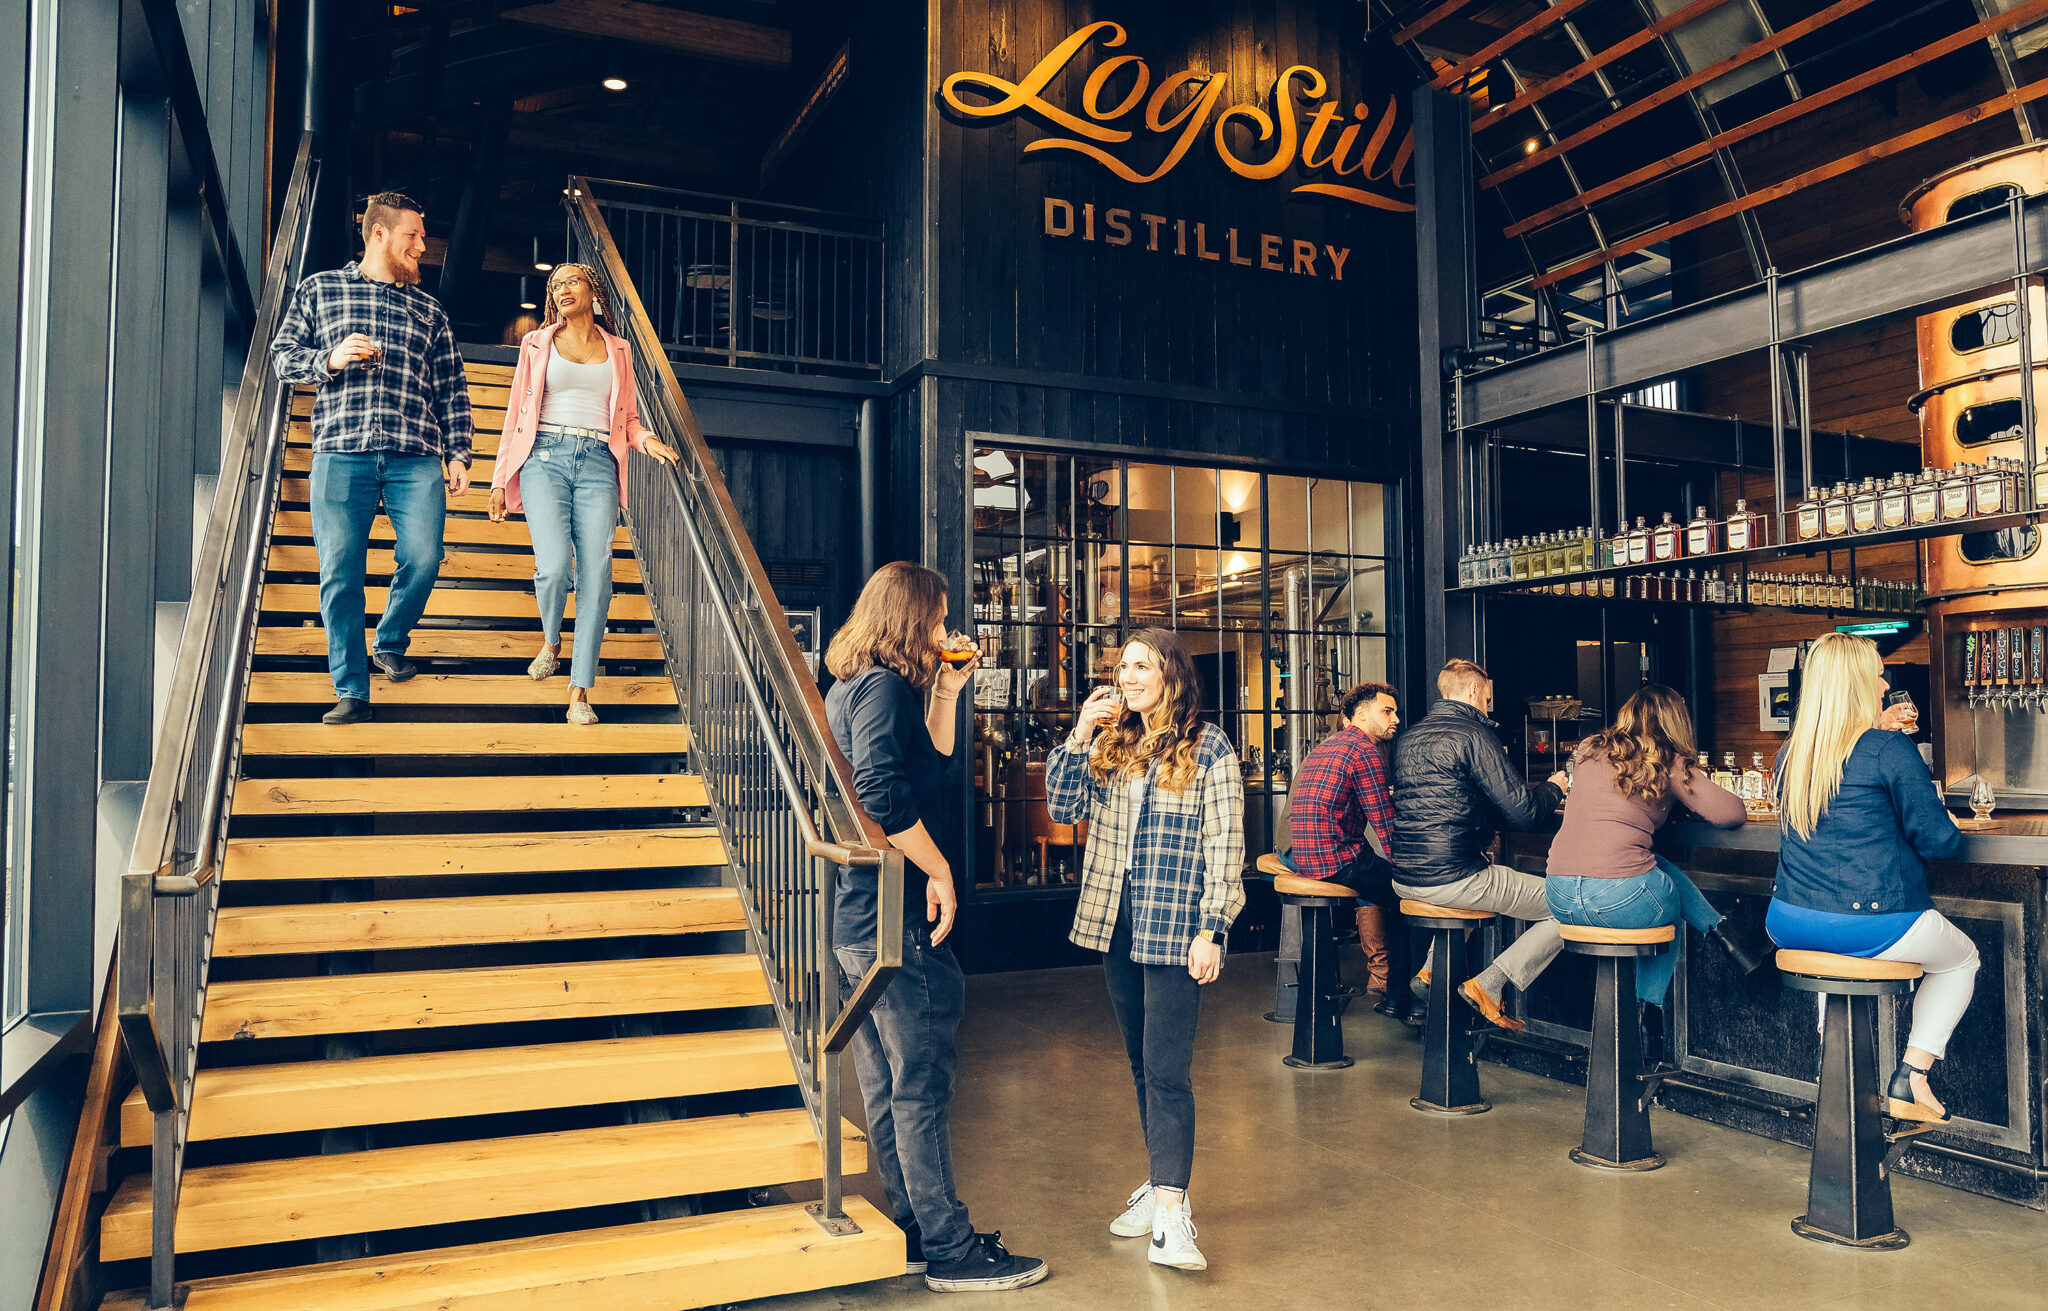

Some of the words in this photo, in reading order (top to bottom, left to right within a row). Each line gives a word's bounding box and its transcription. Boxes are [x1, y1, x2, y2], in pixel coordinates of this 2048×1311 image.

[942, 21, 1228, 183] Log
[1214, 65, 1416, 188] Still
[1044, 197, 1351, 281] DISTILLERY
[1997, 629, 2006, 676] BUSCH
